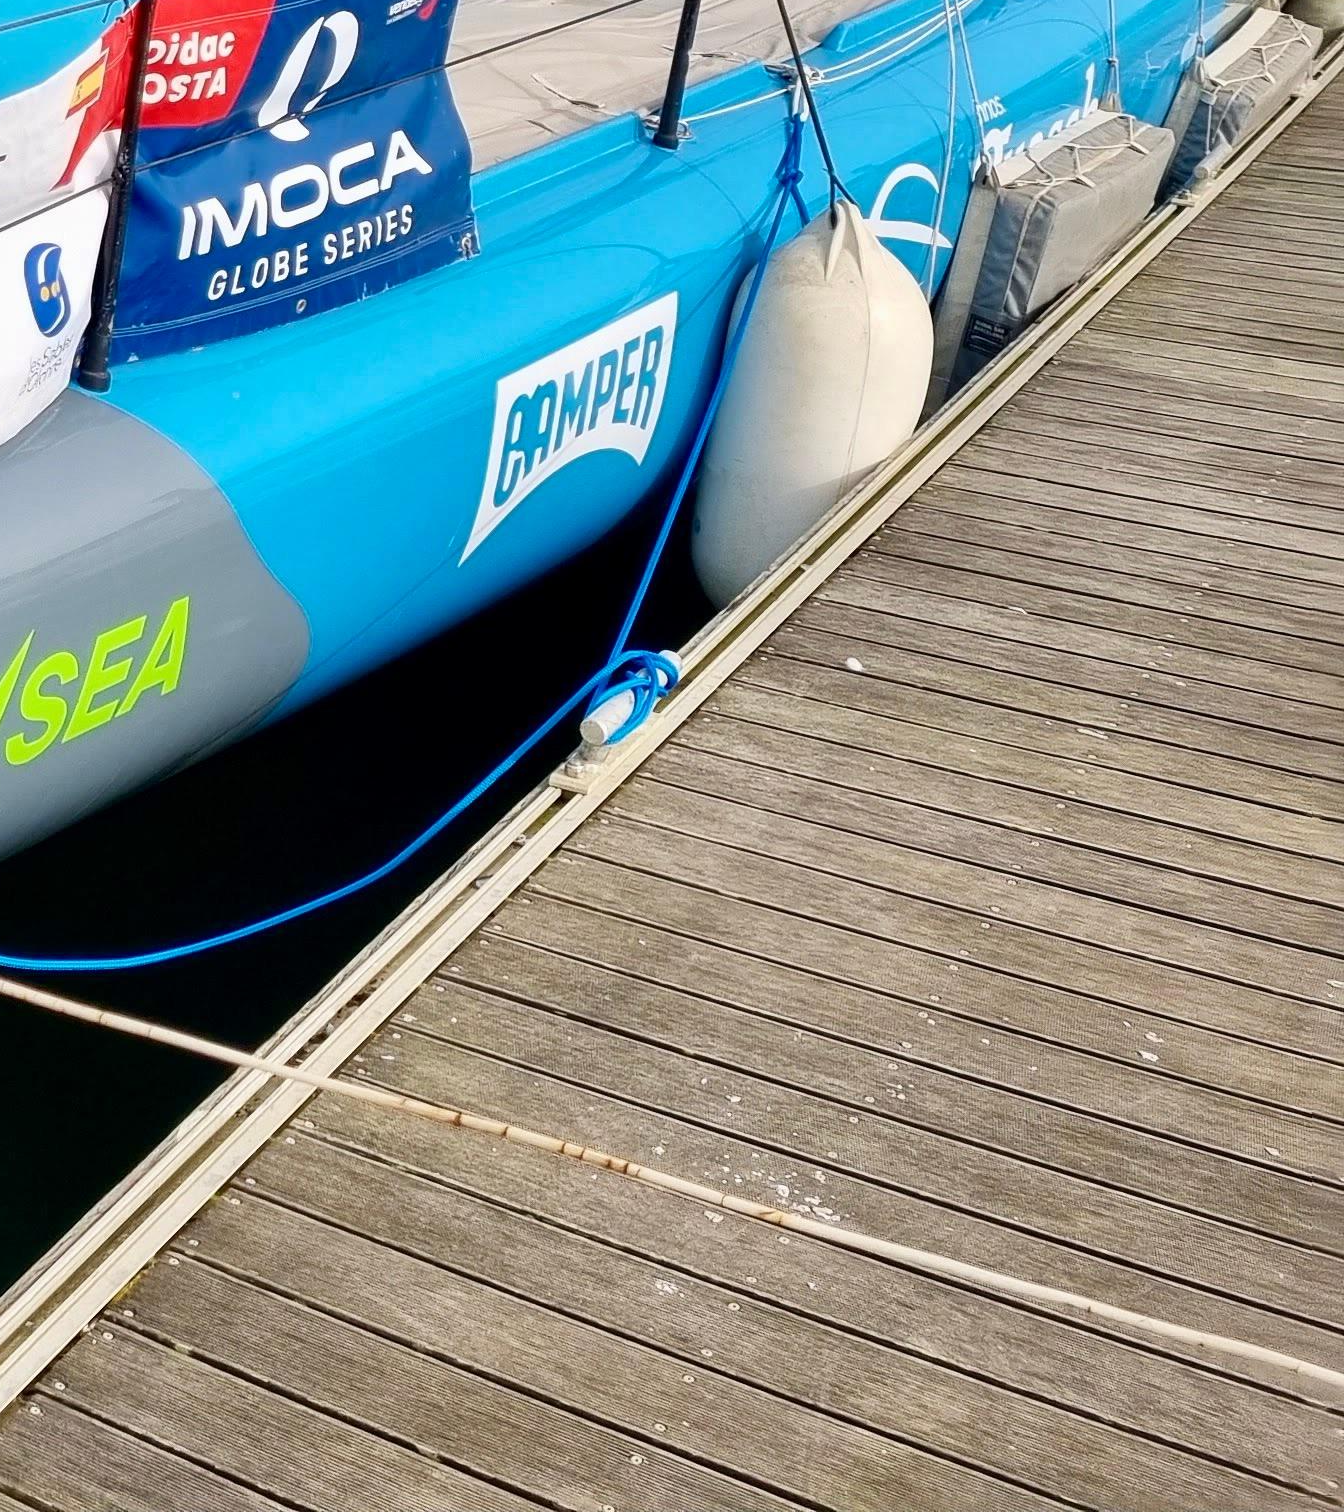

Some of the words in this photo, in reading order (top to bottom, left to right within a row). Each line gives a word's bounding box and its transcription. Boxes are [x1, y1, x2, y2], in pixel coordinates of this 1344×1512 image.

[142, 66, 227, 105] OSTA
[147, 31, 236, 66] Didac
[178, 130, 433, 261] IMOCA
[207, 242, 309, 301] GLOBE
[323, 204, 413, 265] SERIES
[493, 325, 664, 508] CAMPER
